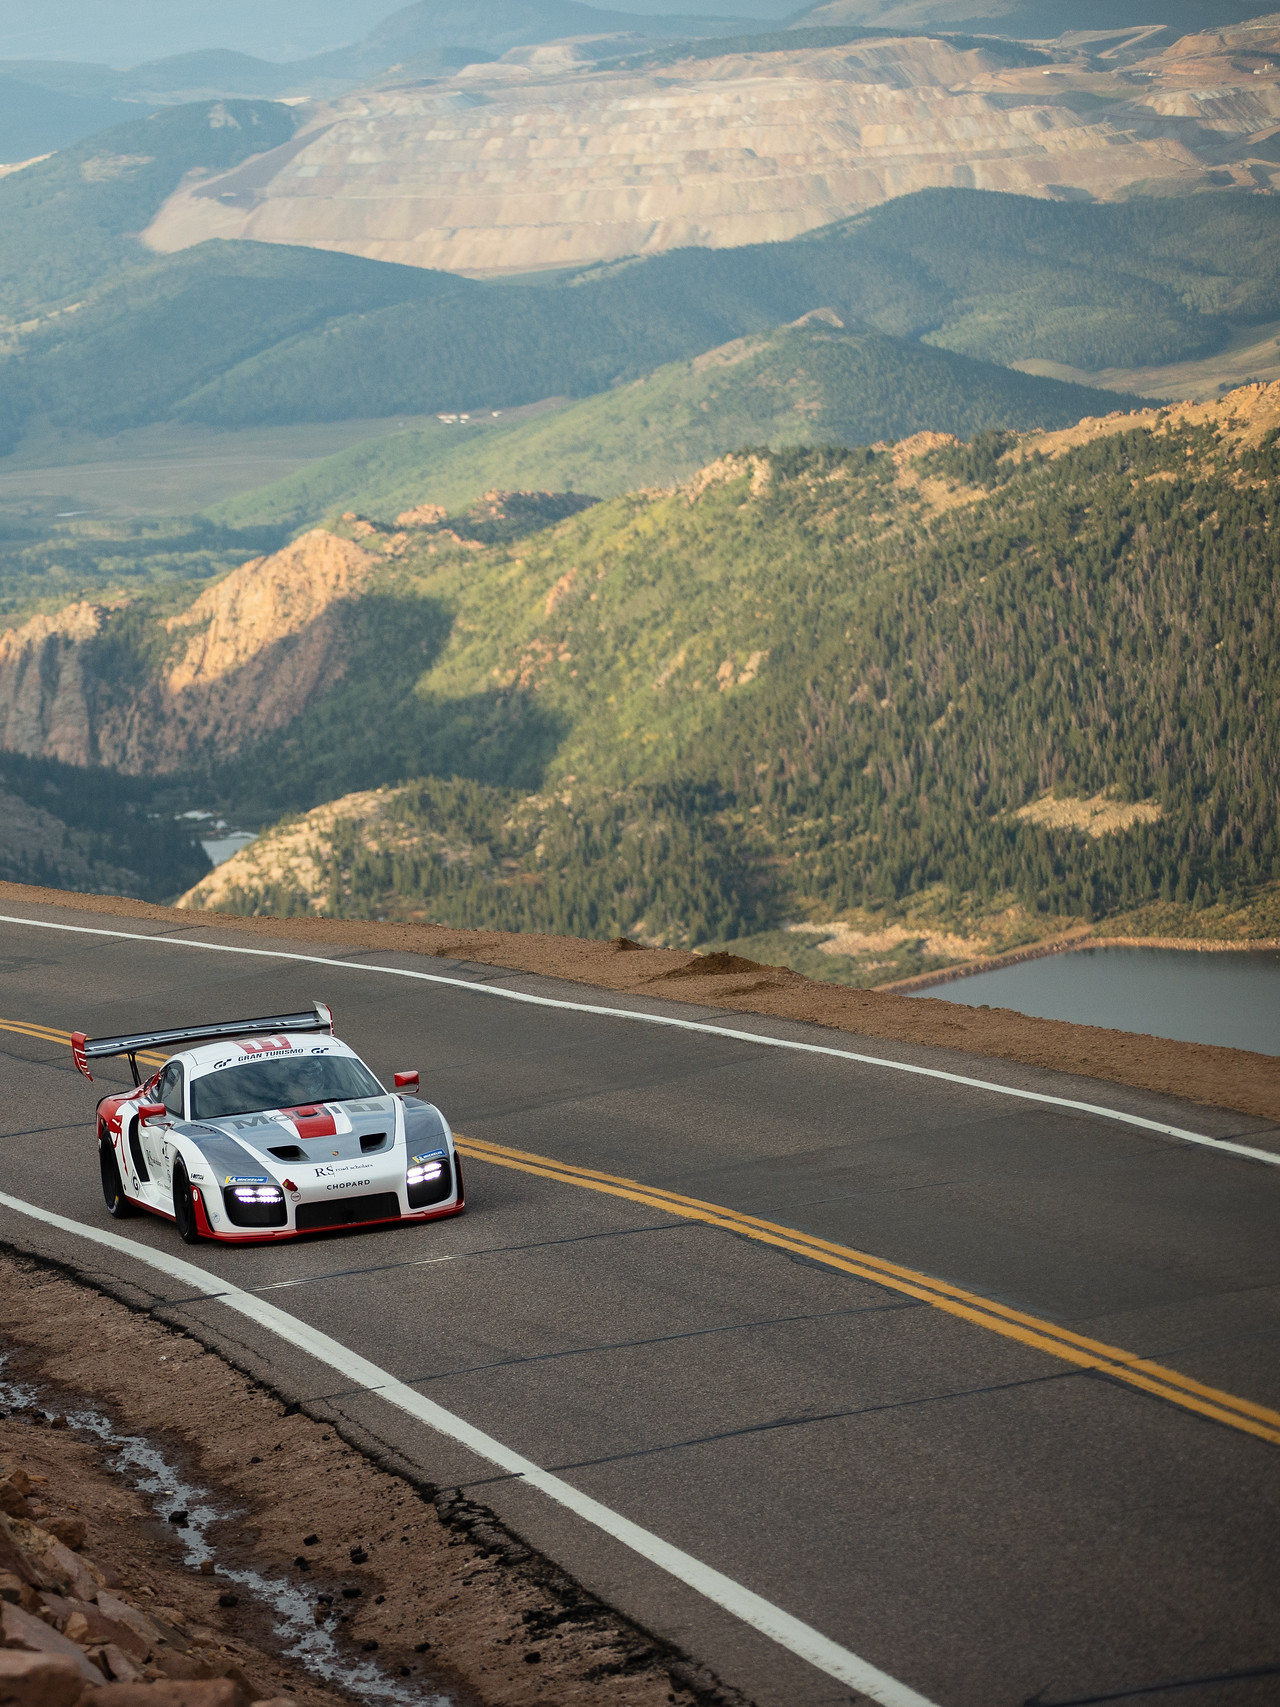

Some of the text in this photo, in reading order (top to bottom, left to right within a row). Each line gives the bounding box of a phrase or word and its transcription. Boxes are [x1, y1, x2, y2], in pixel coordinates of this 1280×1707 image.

[244, 1037, 283, 1050] 11
[238, 1048, 304, 1061] GRAN TURISMO
[314, 1165, 335, 1177] RS
[327, 1180, 370, 1190] CHOPARD
